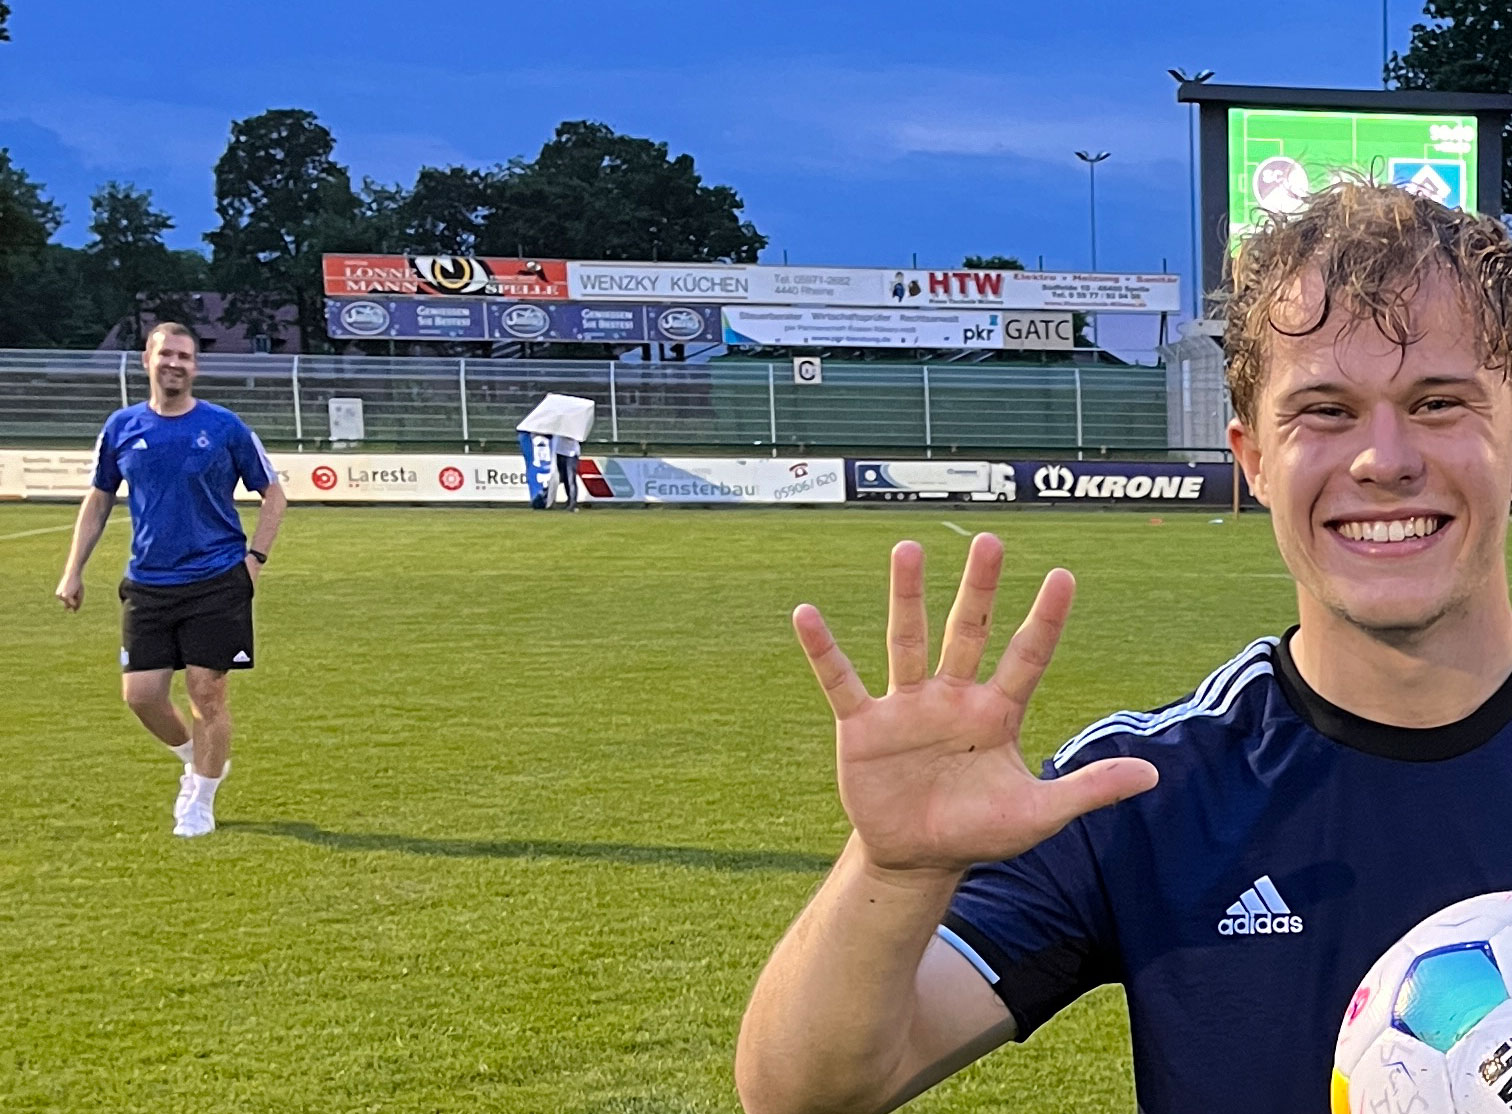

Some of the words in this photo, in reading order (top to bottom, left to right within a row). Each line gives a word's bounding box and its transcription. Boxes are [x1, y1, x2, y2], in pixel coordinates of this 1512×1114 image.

[346, 280, 418, 292] MANN
[580, 274, 659, 292] WENZKY
[670, 273, 748, 293] KÜCHEN
[929, 272, 1003, 297] HTW
[1013, 273, 1056, 281] Elektro
[1072, 275, 1119, 284] Heizung
[485, 283, 560, 295] SPELLE
[963, 324, 995, 344] pkr
[1005, 319, 1070, 340] GATC
[799, 360, 816, 381] C
[348, 466, 418, 483] Laresta
[645, 480, 756, 498] Fensterbau
[1074, 475, 1205, 499] KRONE
[1218, 912, 1304, 936] adidas
